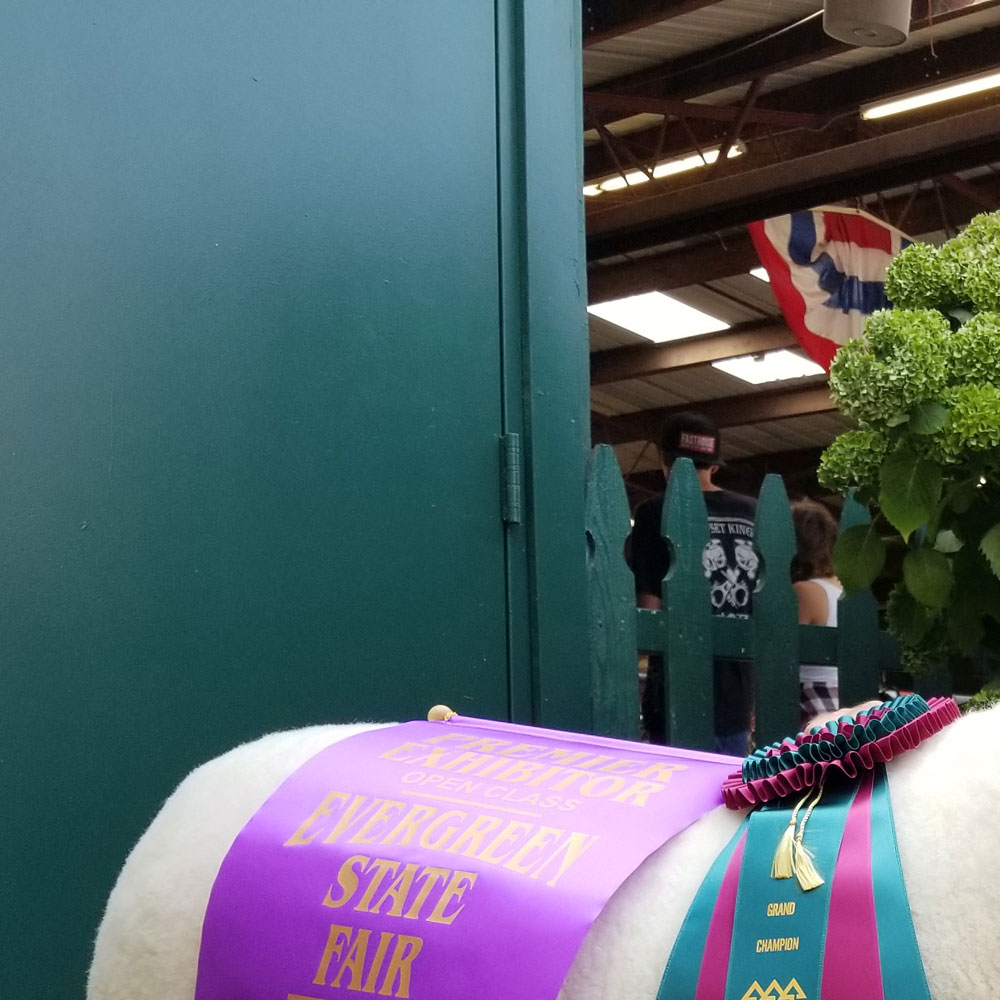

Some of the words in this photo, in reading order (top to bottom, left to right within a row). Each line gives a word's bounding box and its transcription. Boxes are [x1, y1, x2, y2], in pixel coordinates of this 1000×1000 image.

[380, 743, 666, 807] EXHIBITOR
[425, 733, 688, 782] PREMIER
[401, 771, 480, 795] OPEN
[484, 784, 581, 811] CLASS
[284, 791, 599, 887] EVERGREEN
[322, 855, 478, 925] STATE
[767, 902, 796, 917] GRAND
[313, 924, 424, 998] FAIR
[756, 937, 799, 953] CHAMPION
